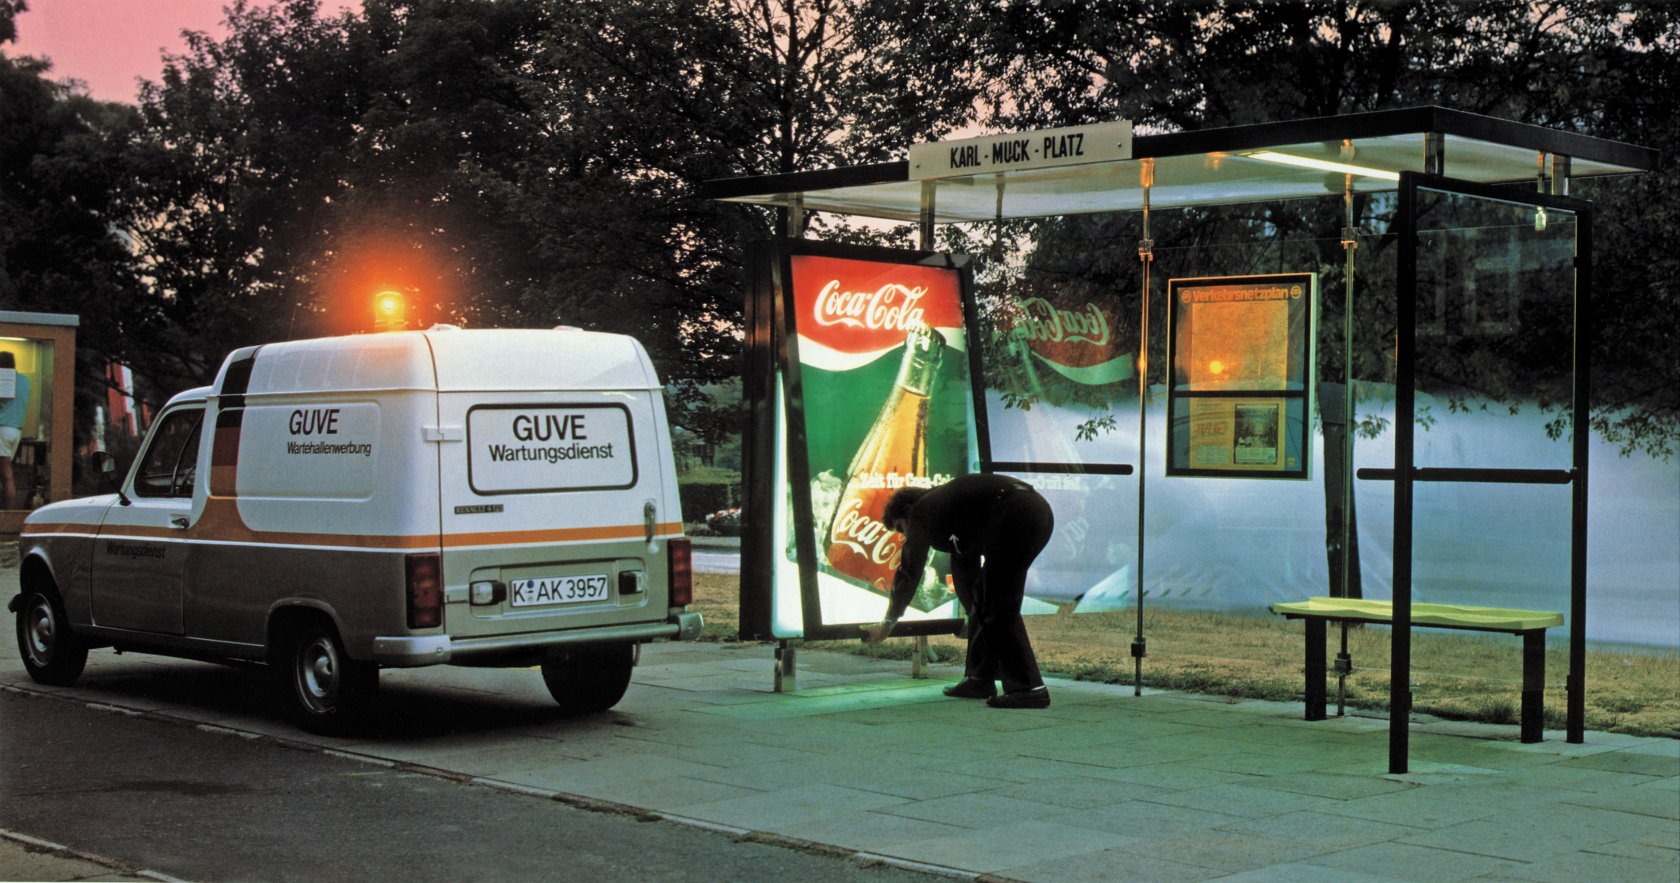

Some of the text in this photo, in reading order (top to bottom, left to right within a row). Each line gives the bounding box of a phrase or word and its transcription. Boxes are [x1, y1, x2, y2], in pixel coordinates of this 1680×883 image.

[950, 144, 982, 169] KARL
[992, 138, 1031, 165] MUCK
[1043, 133, 1085, 160] PLATZ
[813, 279, 929, 331] Coca-Cola
[1192, 287, 1289, 303] Verkehrsnetzplan
[289, 408, 341, 436] GUVE
[512, 415, 587, 441] GUVE
[286, 440, 372, 457] Wartehallenwerbung
[488, 443, 614, 463] Wartungsdienst
